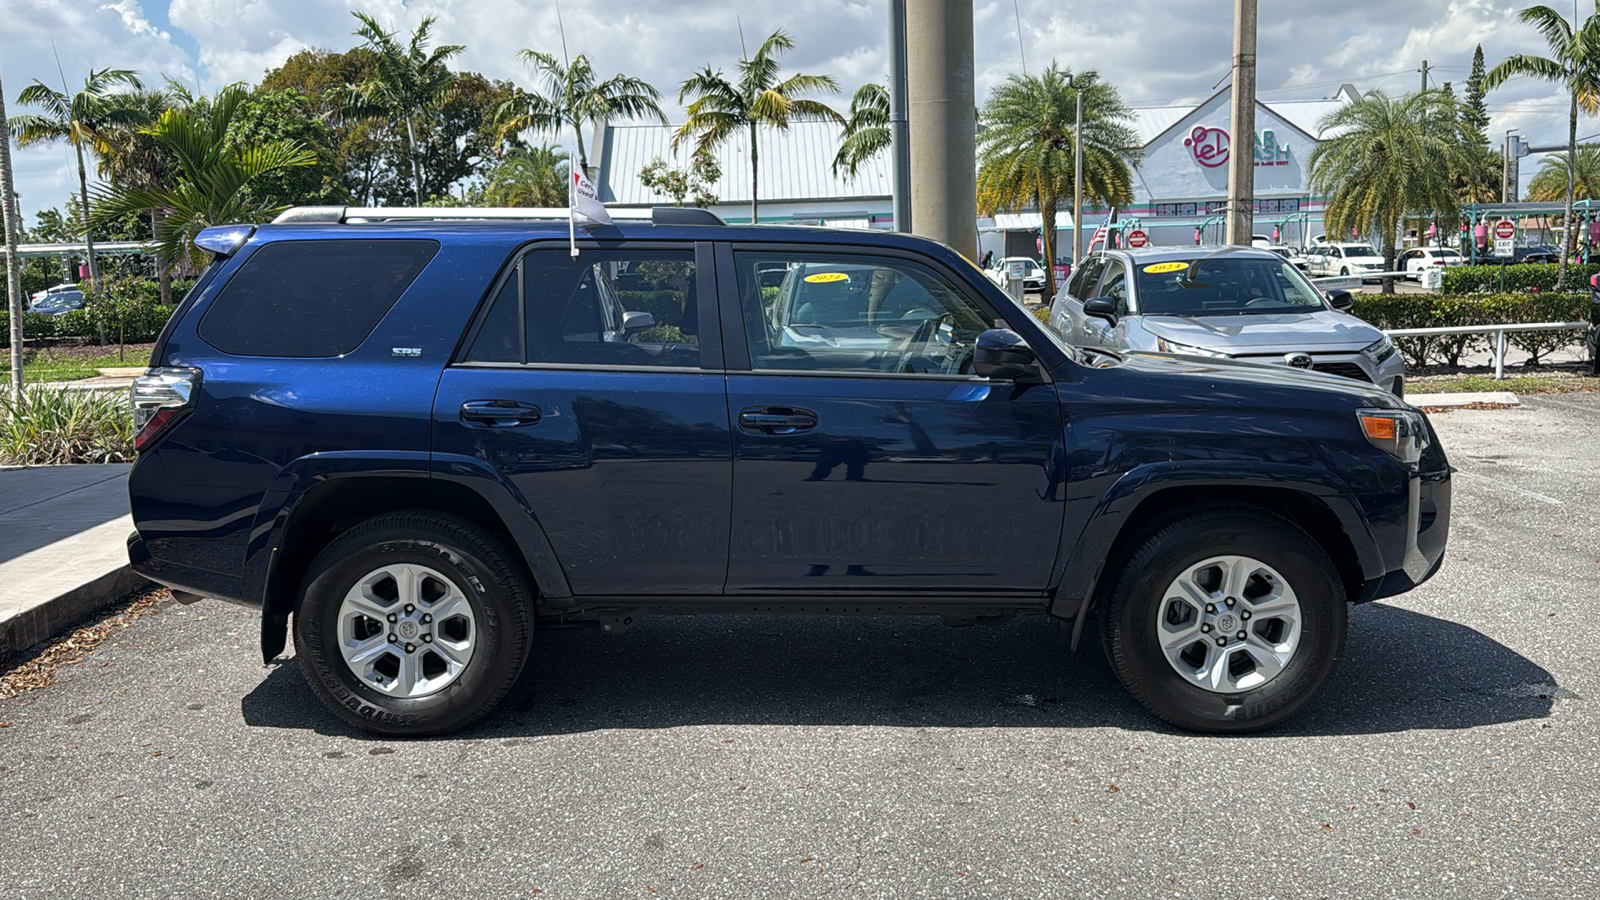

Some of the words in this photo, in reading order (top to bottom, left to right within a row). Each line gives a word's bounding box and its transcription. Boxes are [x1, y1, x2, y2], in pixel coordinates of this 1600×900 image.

[1254, 145, 1290, 160] ASH
[578, 188, 594, 199] Used
[1152, 263, 1181, 272] 2024
